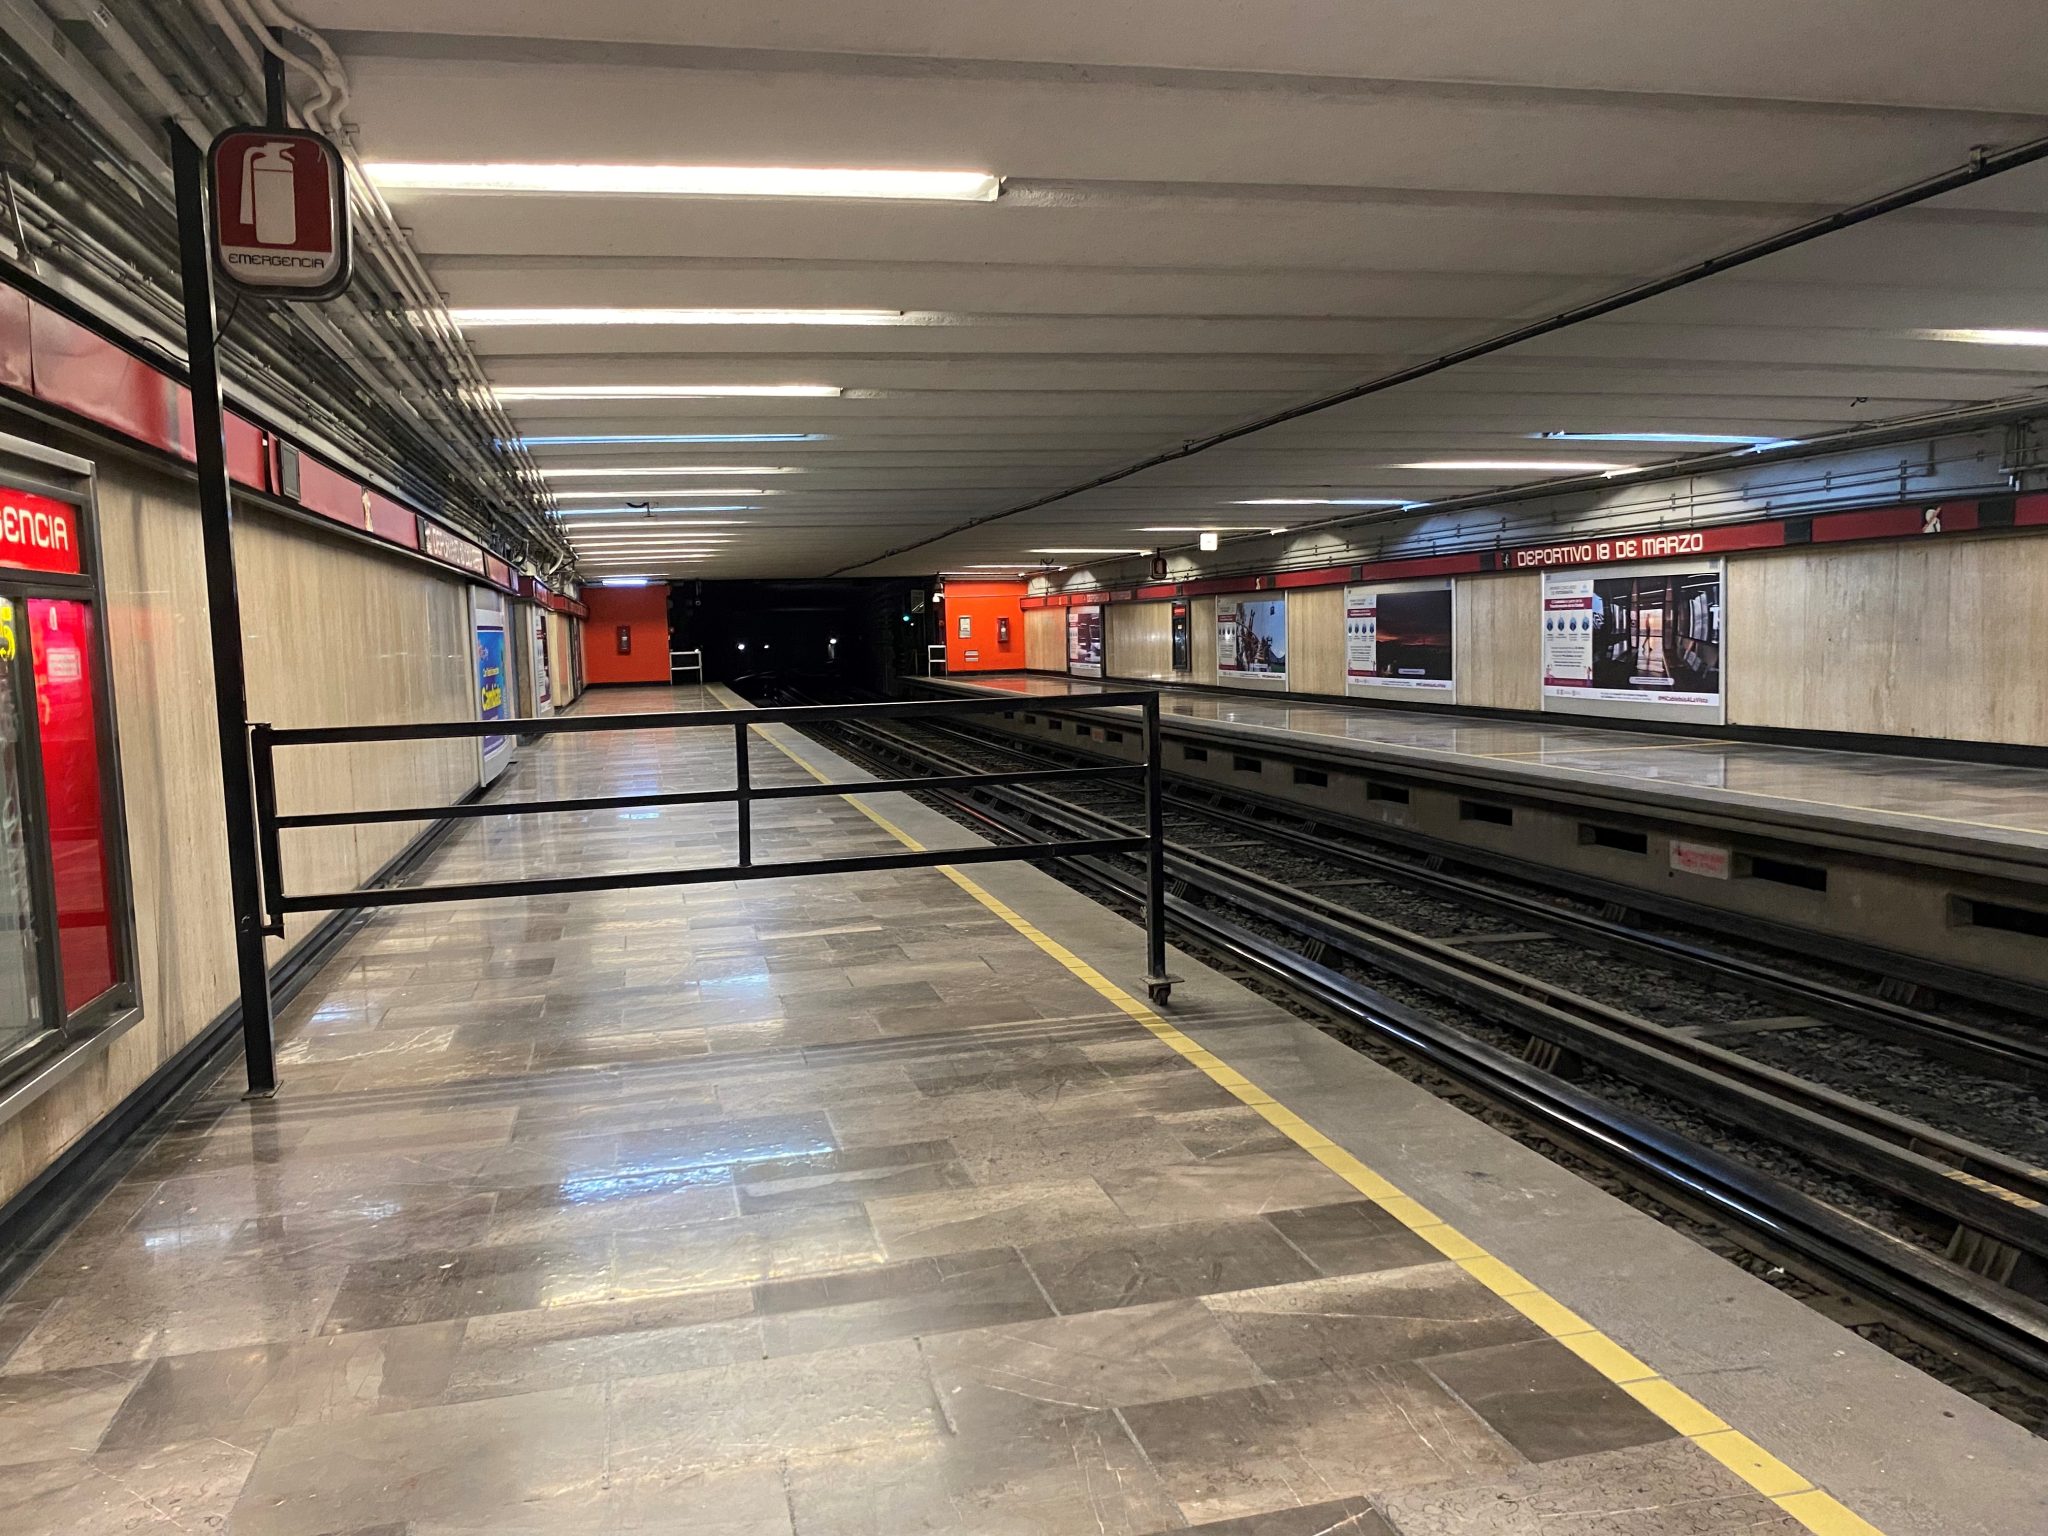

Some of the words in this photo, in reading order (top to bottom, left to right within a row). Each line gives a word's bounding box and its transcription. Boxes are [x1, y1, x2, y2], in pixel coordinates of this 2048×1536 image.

[228, 253, 325, 269] EMERGENCIA
[1517, 545, 1592, 567] DEPORTIVO
[1596, 543, 1611, 561] 18
[1616, 541, 1638, 558] DE
[1642, 533, 1704, 556] MARZO
